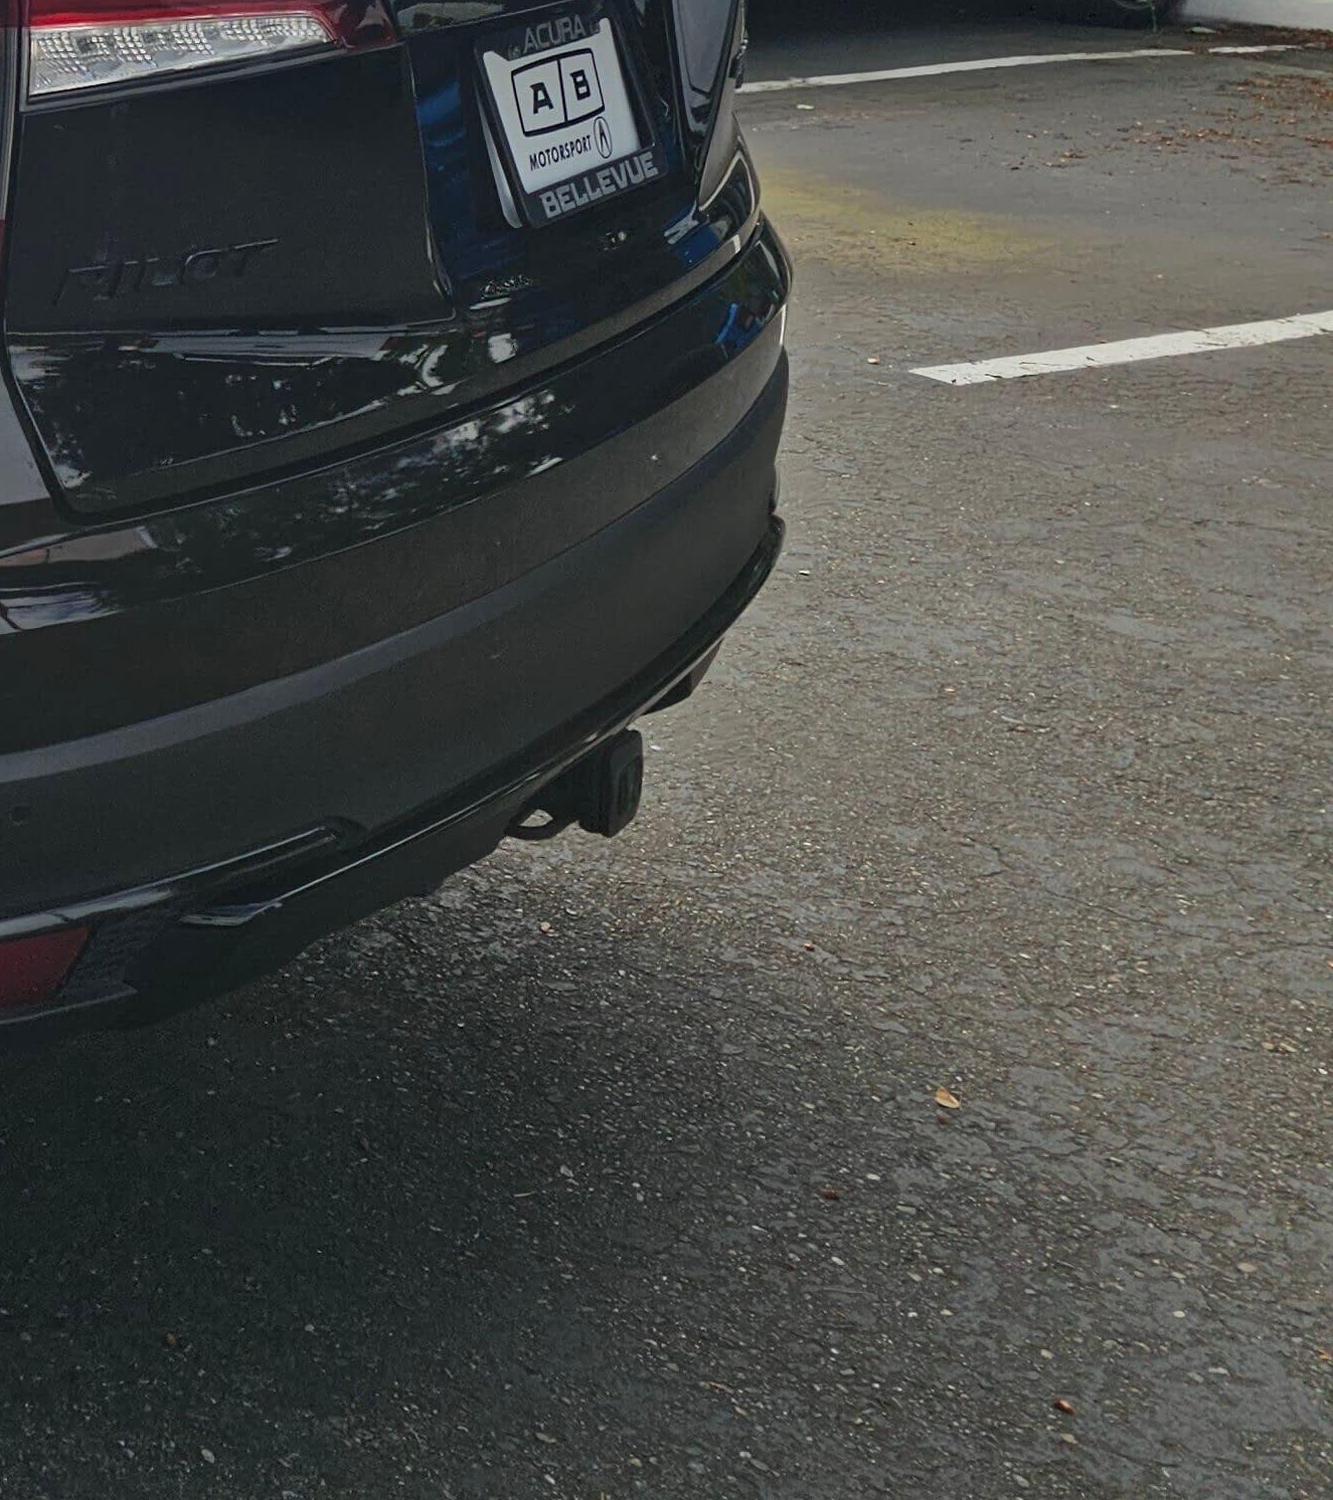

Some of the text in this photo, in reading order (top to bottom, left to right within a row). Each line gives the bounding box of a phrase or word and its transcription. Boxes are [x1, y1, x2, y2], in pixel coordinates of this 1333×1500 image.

[522, 13, 586, 53] ACURA
[529, 134, 592, 172] MOTORSPORT
[539, 151, 659, 219] BELLEVUE
